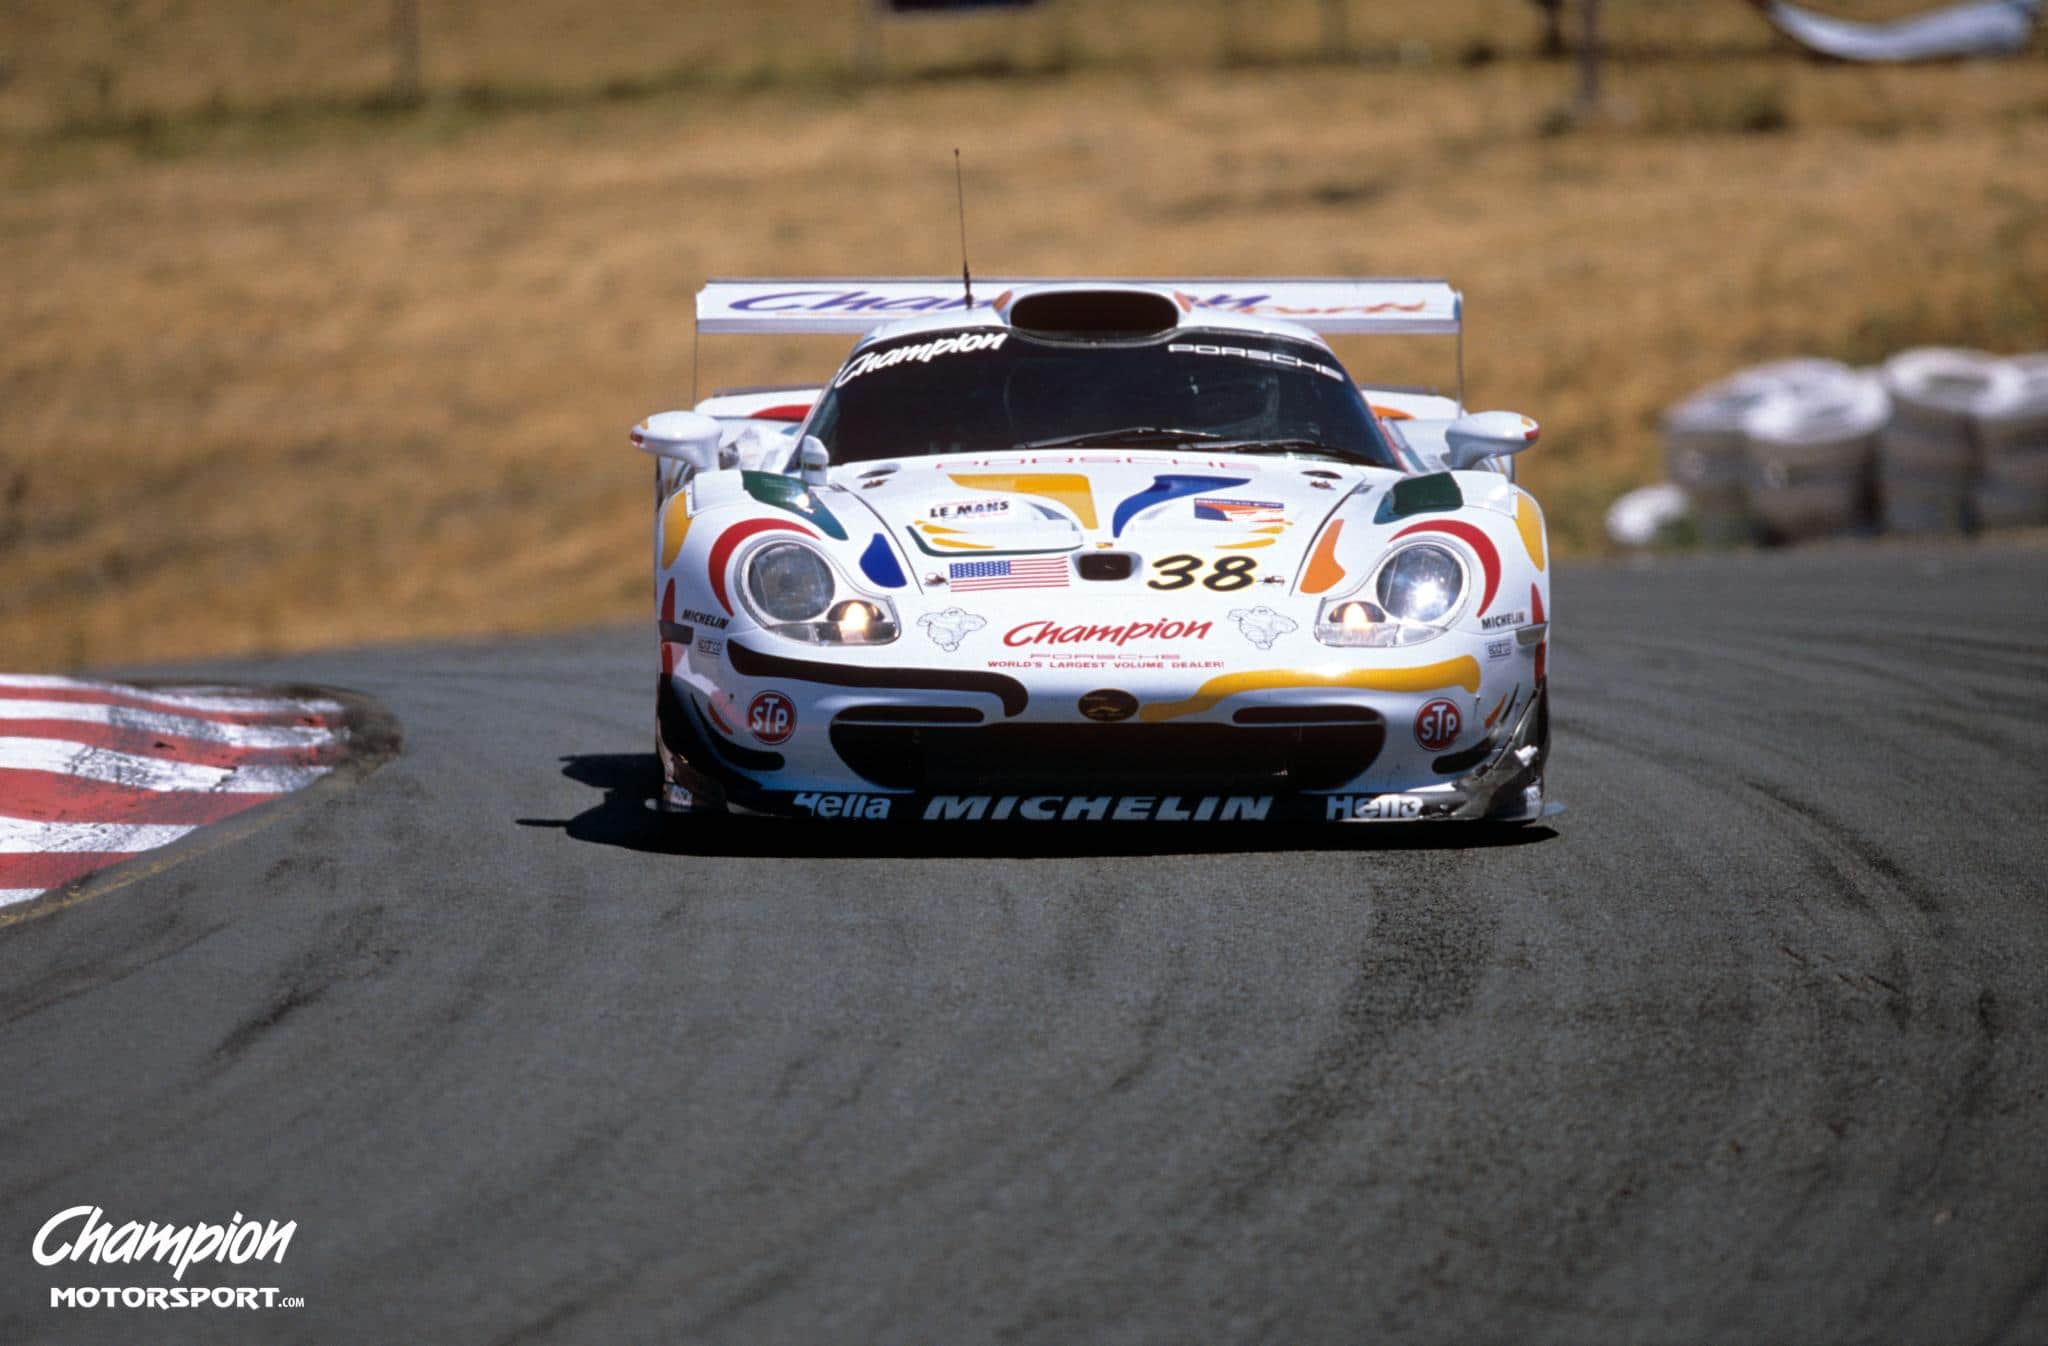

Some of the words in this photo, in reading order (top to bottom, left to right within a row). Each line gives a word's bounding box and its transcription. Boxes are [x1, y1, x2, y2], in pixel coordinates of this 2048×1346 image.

[833, 331, 1009, 389] Champion
[1167, 342, 1345, 381] PORSCHE
[930, 507, 950, 519] LE
[956, 500, 1009, 517] MANS
[1147, 553, 1258, 592] 38
[681, 609, 730, 630] MICHELIN
[1003, 617, 1213, 648] Champion
[1481, 611, 1526, 631] MICHELIN
[987, 661, 1043, 669] WORLD'S
[1050, 661, 1107, 669] LARGEST
[1113, 661, 1164, 669] VOLUME
[1171, 661, 1225, 669] DEALER!
[752, 697, 788, 735] STP
[1421, 704, 1458, 742] STP
[793, 792, 892, 819] Hella
[922, 795, 1274, 821] MICHELIN
[1326, 792, 1424, 819] Hella
